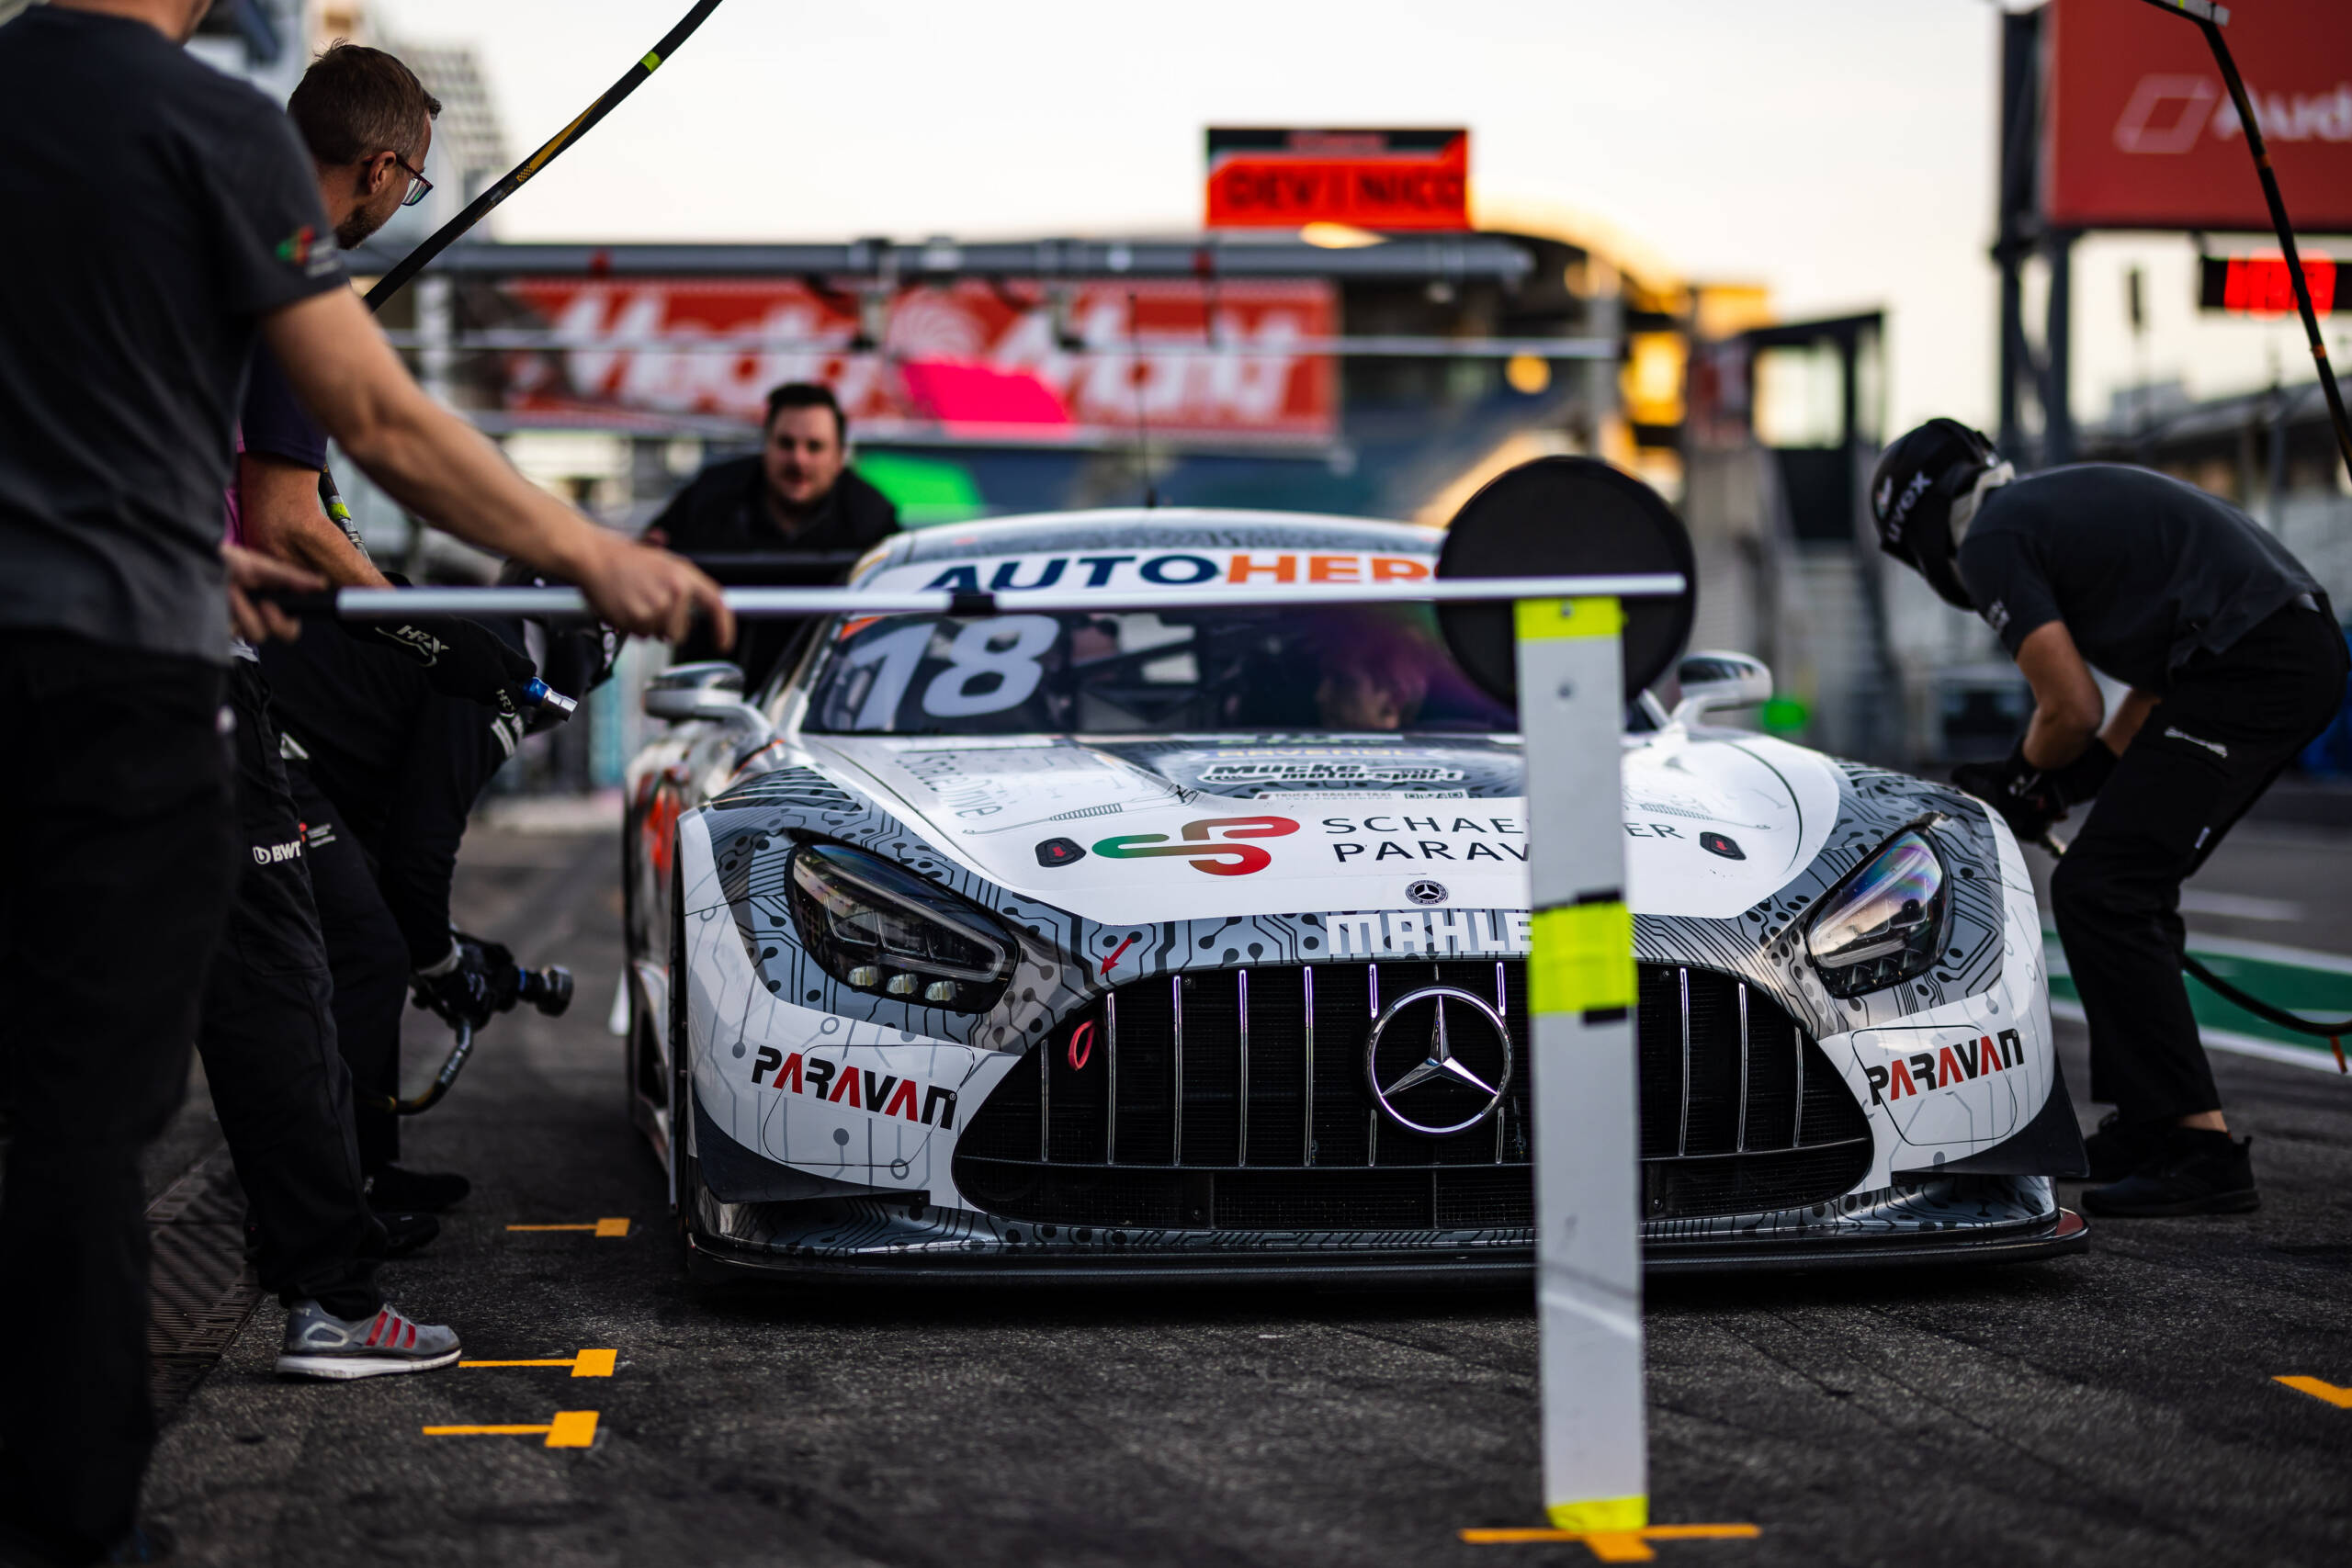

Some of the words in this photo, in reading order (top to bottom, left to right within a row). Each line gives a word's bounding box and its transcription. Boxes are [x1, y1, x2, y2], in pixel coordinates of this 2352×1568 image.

[922, 554, 1435, 591] AUTOHER
[850, 615, 1060, 731] 18
[271, 840, 301, 862] BWT
[1332, 840, 1530, 863] PARAV
[751, 1044, 957, 1130] PARAVAN
[1866, 1028, 2025, 1106] PARAVAN
